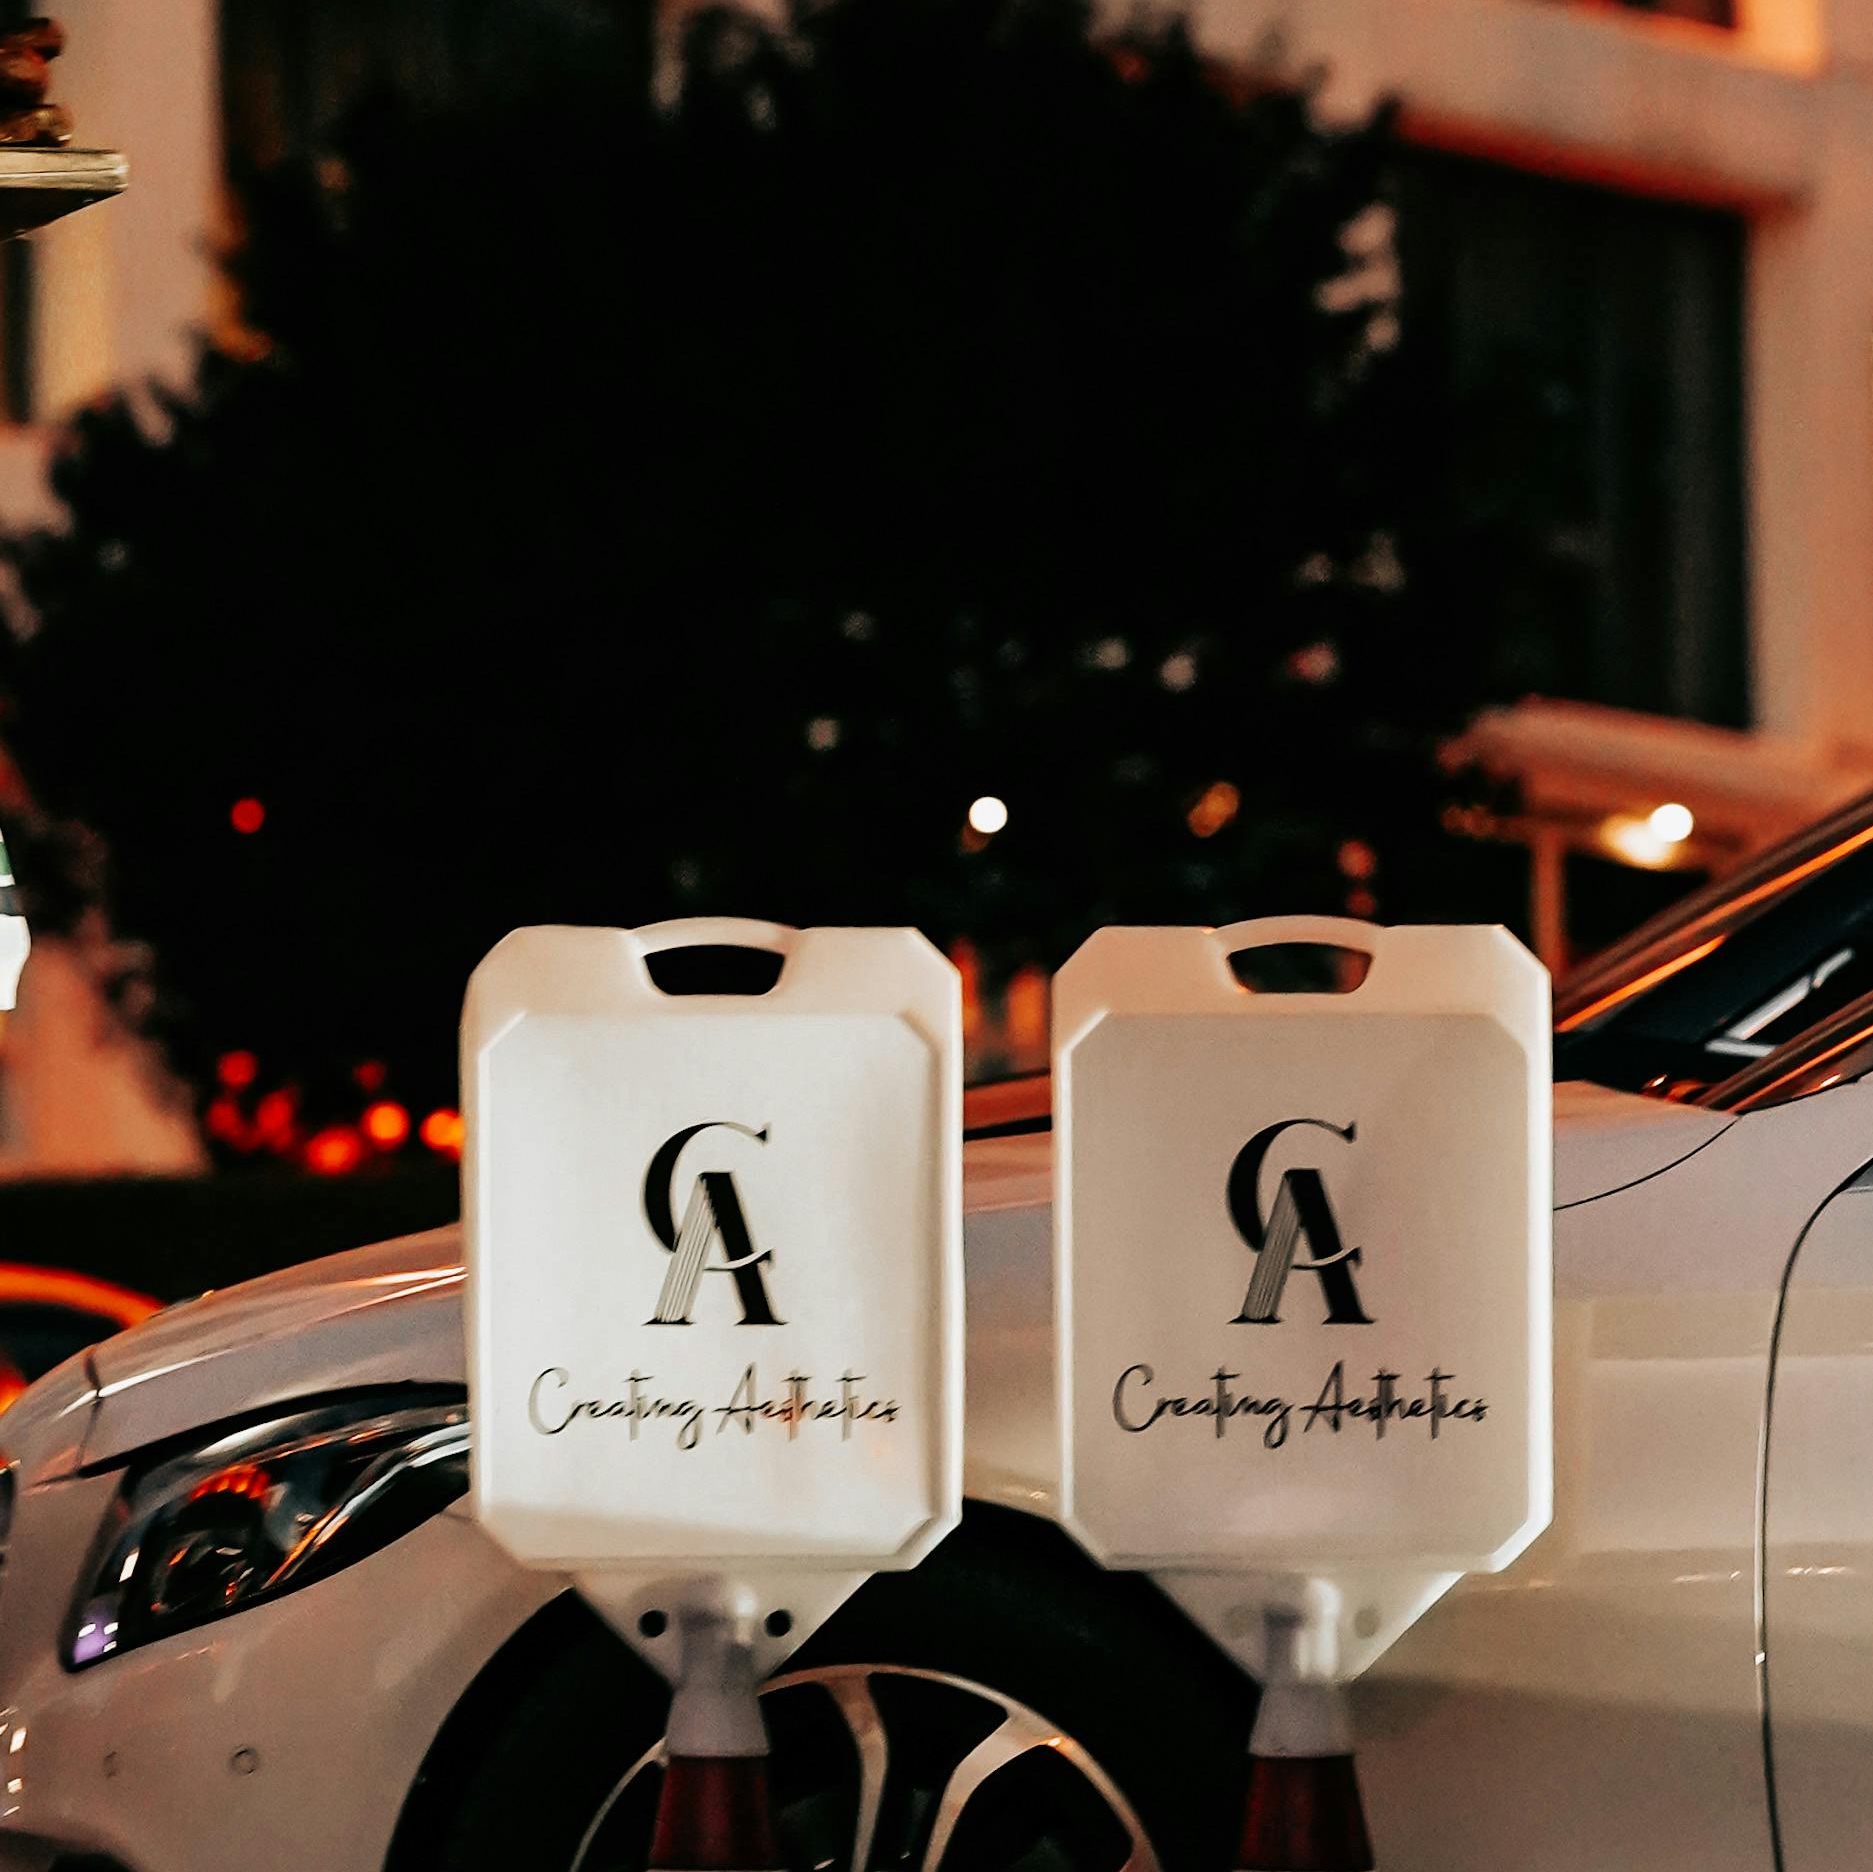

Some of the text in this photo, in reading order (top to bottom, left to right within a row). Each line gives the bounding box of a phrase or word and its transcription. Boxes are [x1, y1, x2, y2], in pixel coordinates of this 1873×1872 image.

[528, 1361, 902, 1450] Creating Aesthetics
[1112, 1360, 1489, 1450] Creating Aesthetics
